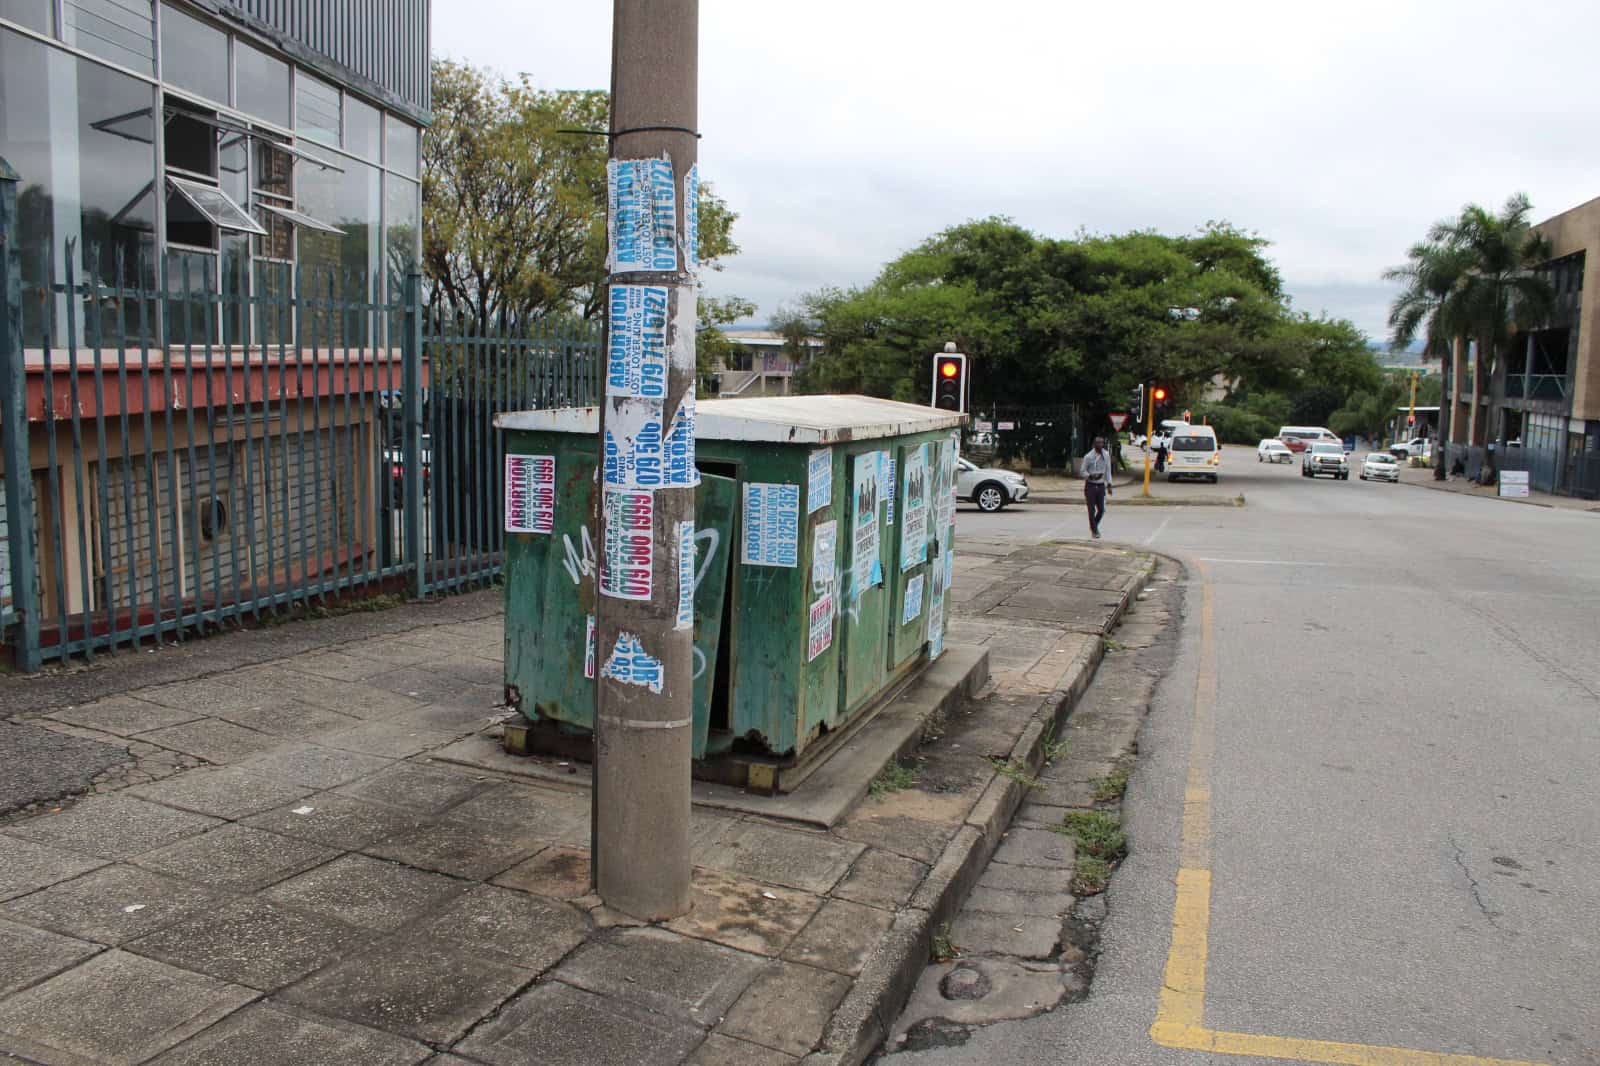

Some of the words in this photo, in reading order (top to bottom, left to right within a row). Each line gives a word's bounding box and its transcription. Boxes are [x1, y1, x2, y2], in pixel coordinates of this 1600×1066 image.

[651, 160, 674, 200] 5727
[616, 161, 635, 262] ABORTION
[652, 206, 674, 231] 711
[641, 212, 651, 242] LOVER
[643, 247, 651, 268] LOST
[652, 236, 676, 269] 079
[643, 287, 667, 328] 5727
[609, 288, 627, 388] ABORTION
[633, 312, 642, 336] KING
[632, 338, 640, 368] LOVER
[641, 332, 665, 359] 711
[631, 371, 640, 395] LOST
[641, 363, 664, 396] 079
[533, 459, 554, 485] 1999
[618, 456, 626, 484] PENIS
[626, 450, 635, 470] CALL
[636, 457, 661, 484] 079
[511, 457, 527, 528] ABORTION
[532, 487, 553, 509] 506
[532, 511, 553, 531] 079
[620, 495, 652, 532] 1999
[747, 487, 761, 561] ABORTION
[620, 535, 652, 566] 506
[777, 542, 797, 565] 066
[620, 569, 651, 596] 079
